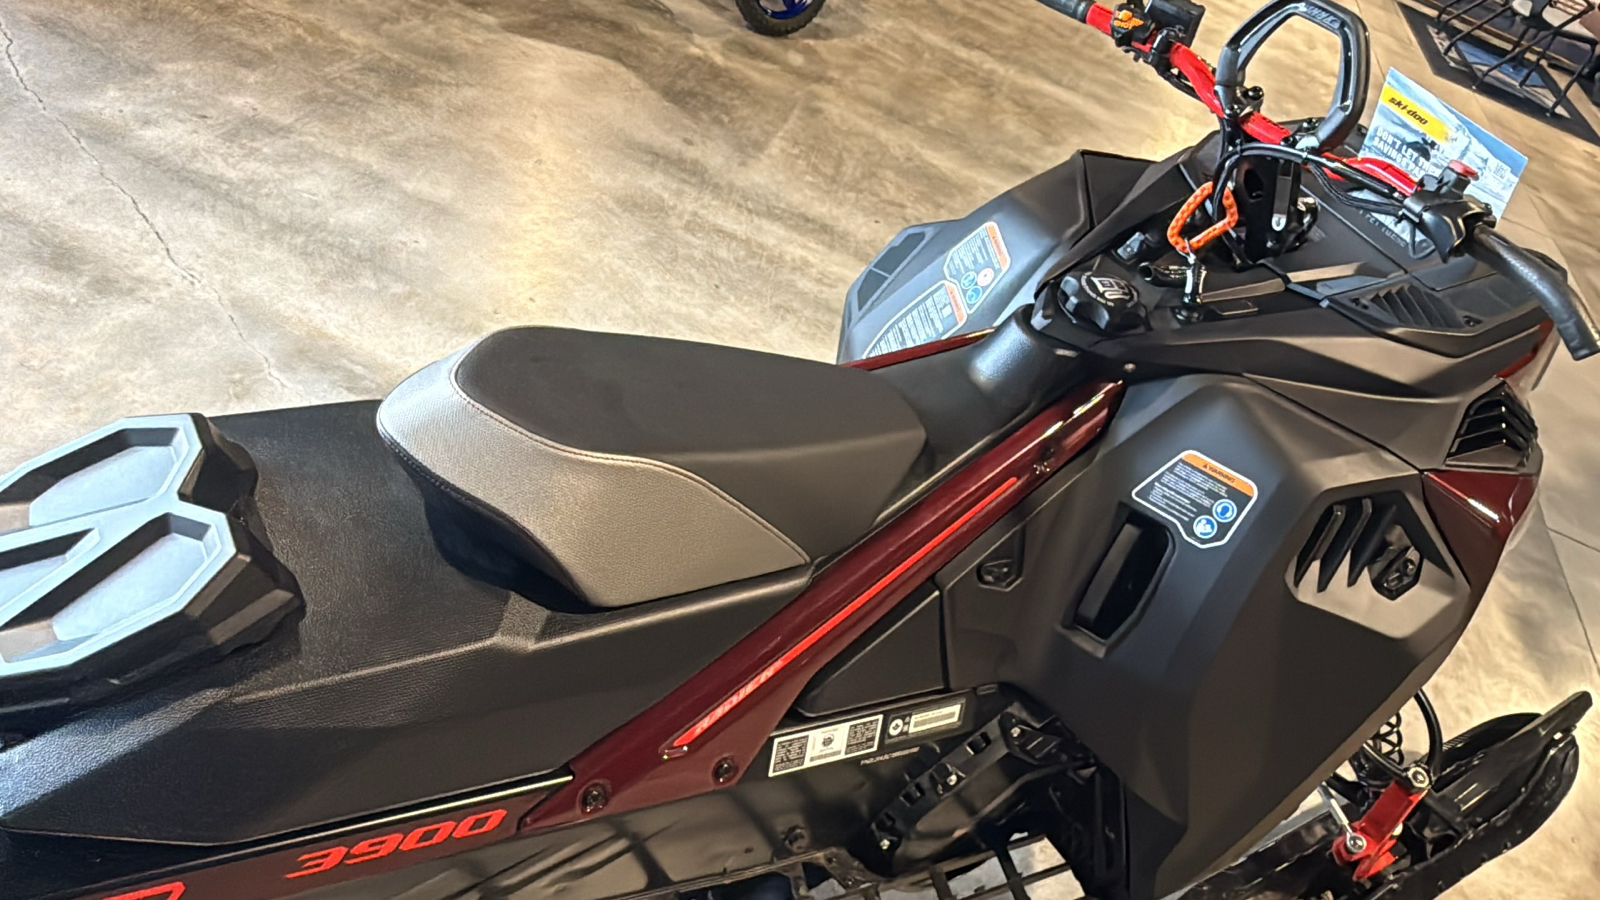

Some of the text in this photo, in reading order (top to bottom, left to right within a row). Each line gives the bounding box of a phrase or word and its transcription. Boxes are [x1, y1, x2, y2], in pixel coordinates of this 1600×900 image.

[1388, 97, 1428, 125] ski-doo
[1376, 127, 1402, 150] DON'T
[1401, 144, 1419, 163] LET
[284, 808, 507, 878] 3900
